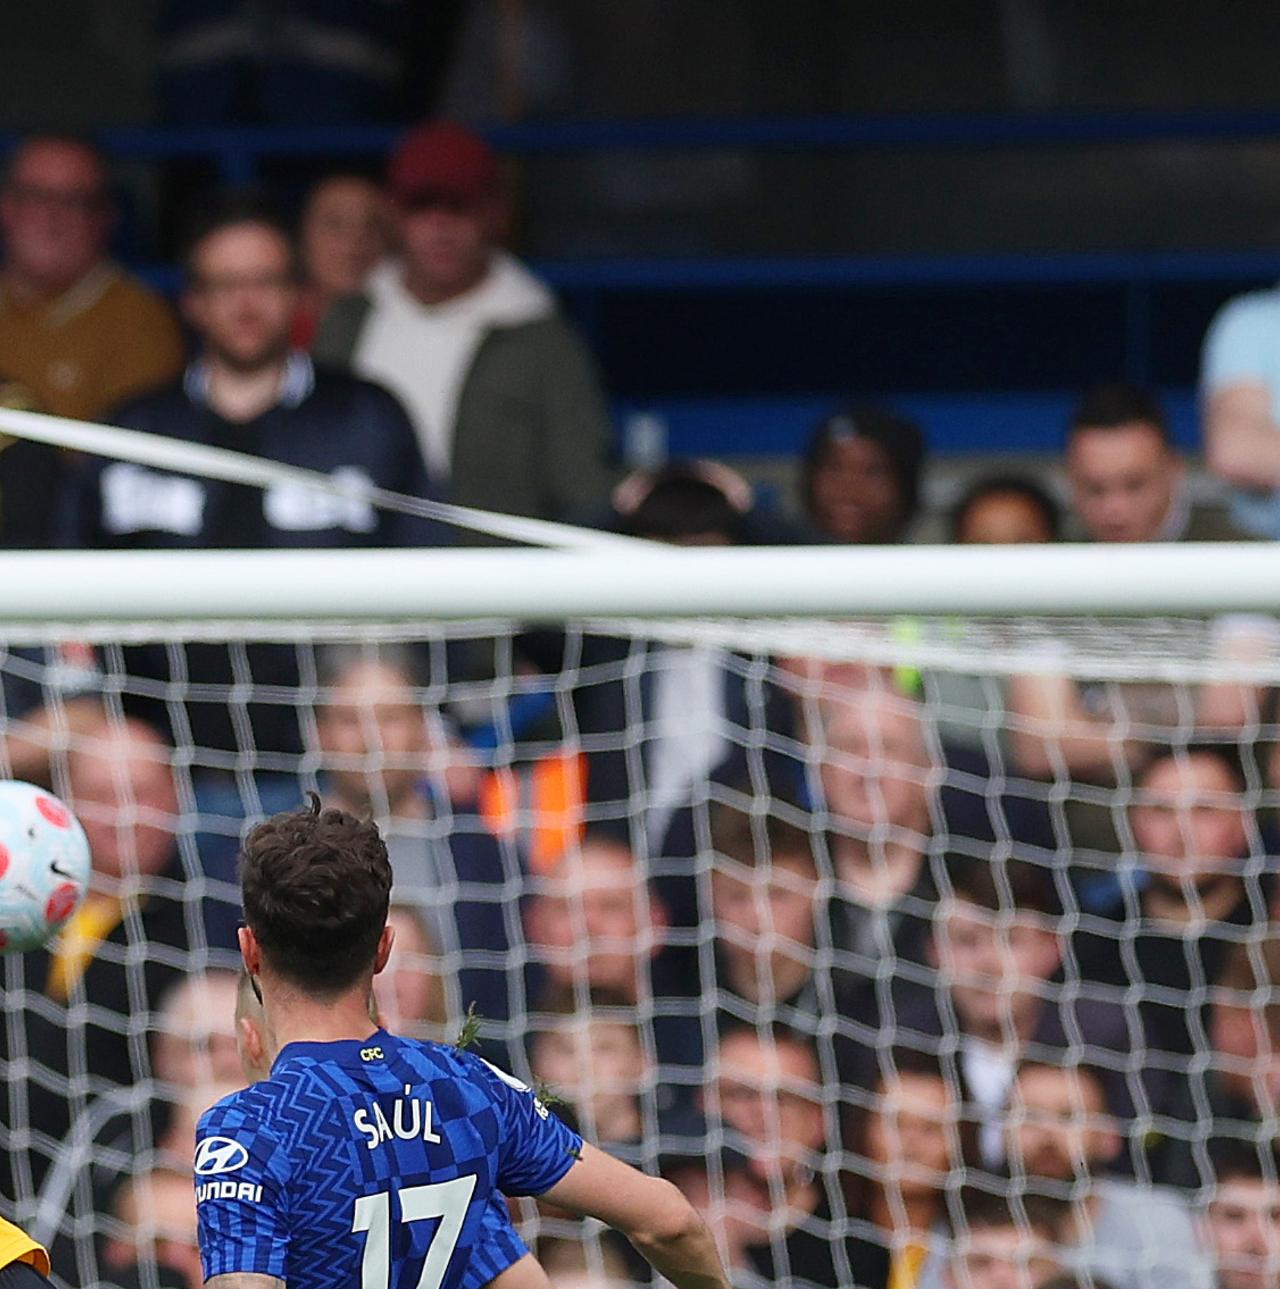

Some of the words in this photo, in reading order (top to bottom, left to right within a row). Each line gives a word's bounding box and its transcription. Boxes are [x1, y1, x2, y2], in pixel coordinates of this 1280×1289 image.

[360, 1047, 384, 1061] CFC
[354, 1084, 440, 1150] SAÚL
[195, 1181, 263, 1204] UNDAI
